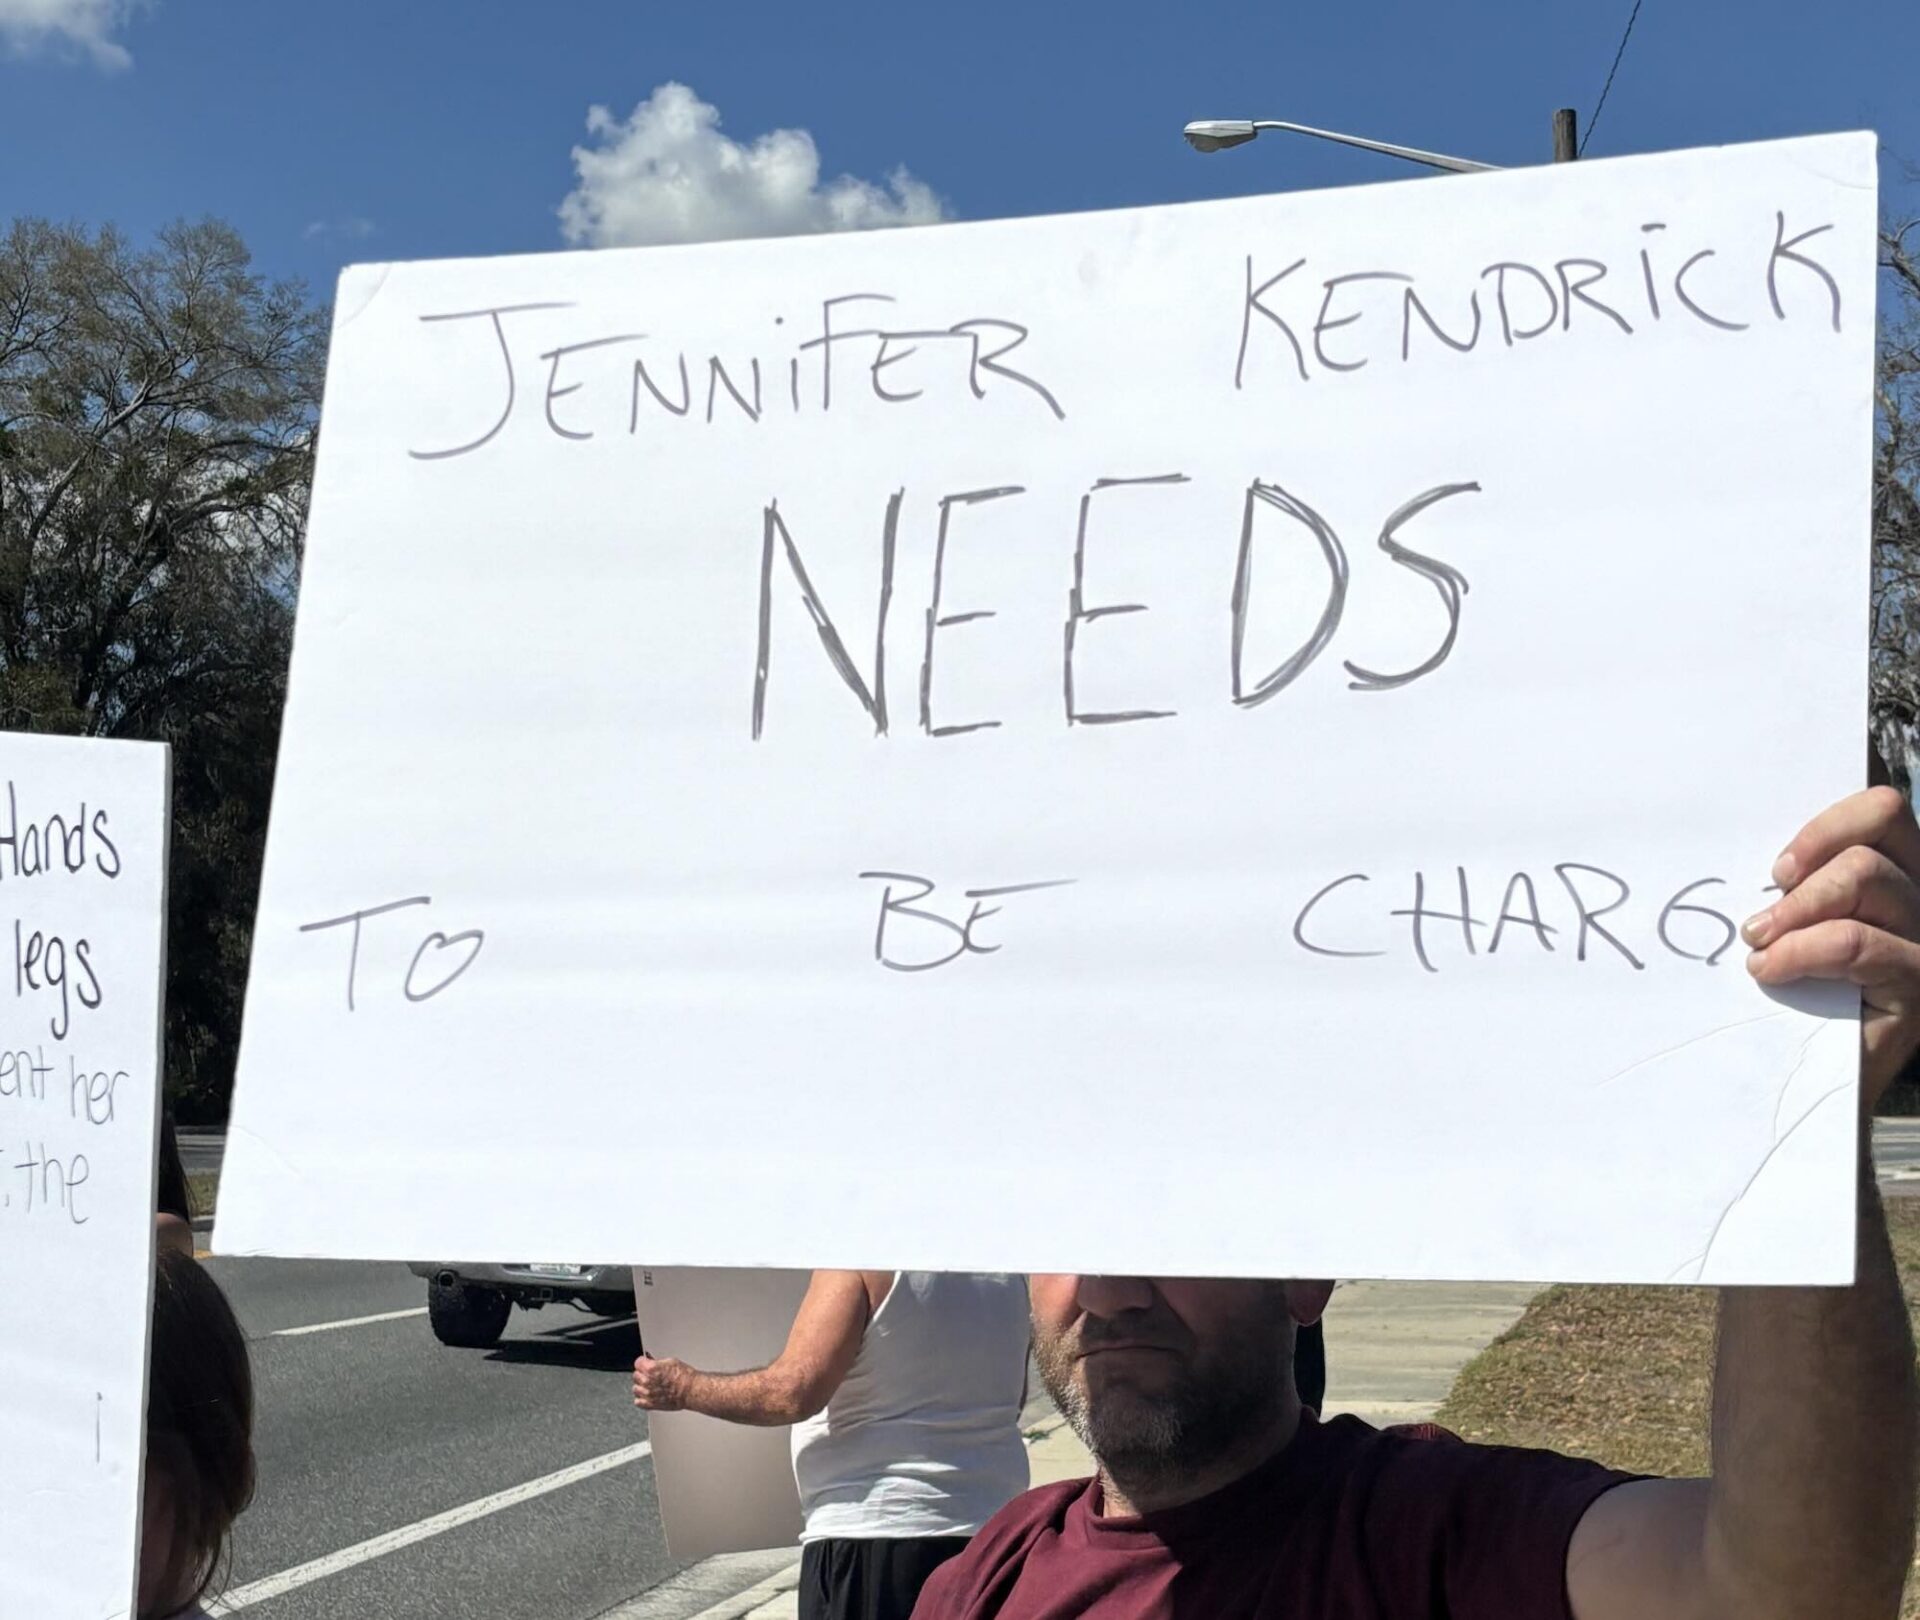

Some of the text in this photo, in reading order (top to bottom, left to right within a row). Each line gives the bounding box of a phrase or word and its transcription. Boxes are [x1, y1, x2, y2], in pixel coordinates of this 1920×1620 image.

[752, 472, 1482, 741] NEEDS
[15, 918, 101, 1041] legs
[299, 862, 1788, 1011] TO BE CHARG
[70, 1055, 130, 1125] her
